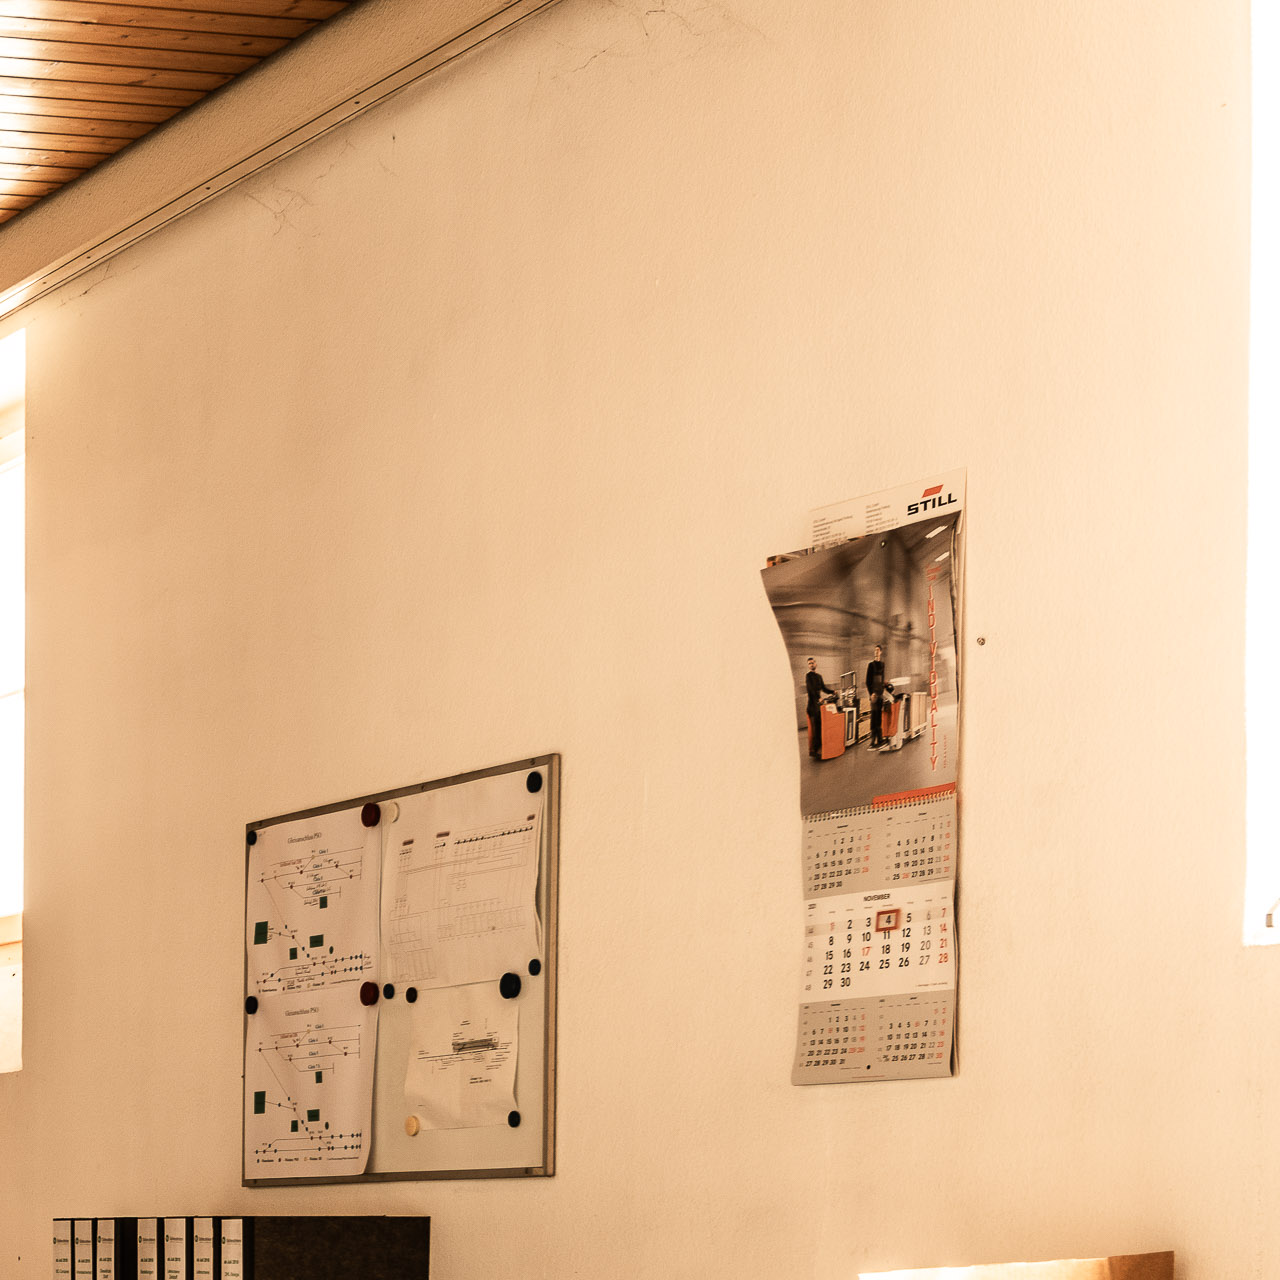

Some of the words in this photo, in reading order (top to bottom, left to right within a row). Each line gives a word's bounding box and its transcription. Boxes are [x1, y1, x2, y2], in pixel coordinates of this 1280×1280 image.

[907, 493, 957, 516] STILL
[928, 584, 938, 771] INDIVIDUALITY
[864, 894, 891, 902] NOVEMBER
[847, 919, 853, 929] 2
[866, 917, 871, 927] 3
[885, 915, 892, 924] 4
[906, 912, 912, 923] 5
[926, 910, 932, 921] 6
[941, 907, 947, 918] 7
[829, 936, 834, 946] 8
[847, 934, 852, 944] 9
[862, 931, 871, 942] 10
[883, 930, 891, 940] 11
[902, 927, 911, 938] 12
[923, 925, 932, 936] 13
[939, 923, 948, 933] 14
[825, 950, 833, 960] 15
[843, 948, 852, 958] 16
[861, 946, 872, 956] 17
[881, 944, 891, 954] 18
[901, 942, 911, 952] 19
[920, 940, 931, 951] 20
[939, 938, 947, 949] 21
[823, 964, 833, 975] 22
[841, 962, 851, 973] 23
[859, 961, 870, 971] 24
[879, 958, 890, 969] 25
[898, 957, 909, 967] 26
[919, 955, 930, 966] 27
[938, 952, 948, 964] 28
[823, 979, 833, 989] 29
[840, 977, 851, 987] 30
